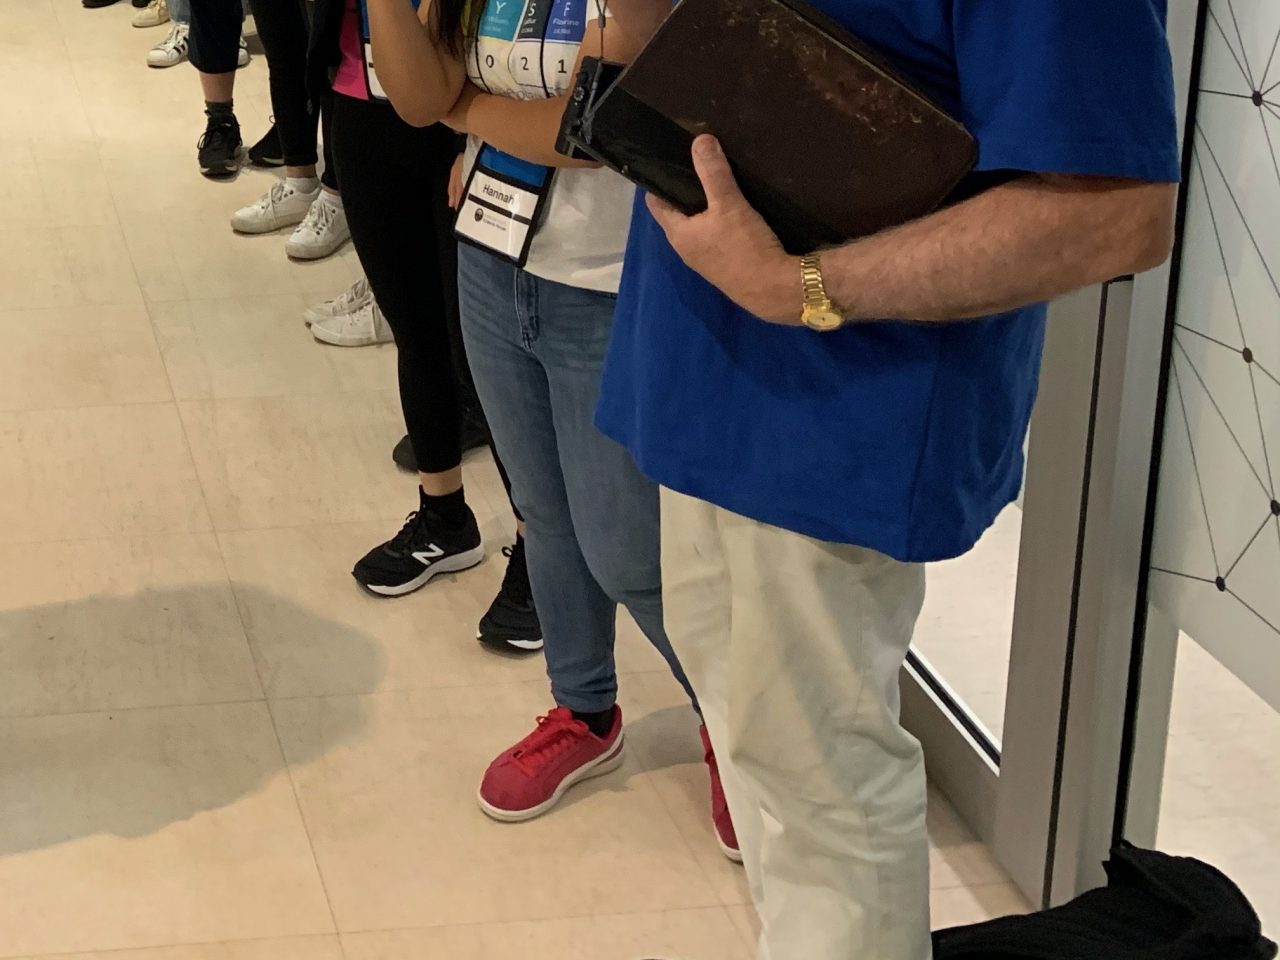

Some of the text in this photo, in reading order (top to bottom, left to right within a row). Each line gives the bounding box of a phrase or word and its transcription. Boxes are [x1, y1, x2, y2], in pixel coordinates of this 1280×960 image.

[495, 1, 572, 17] Y S F
[485, 54, 568, 74] 0 2 1
[482, 183, 515, 205] Hannah
